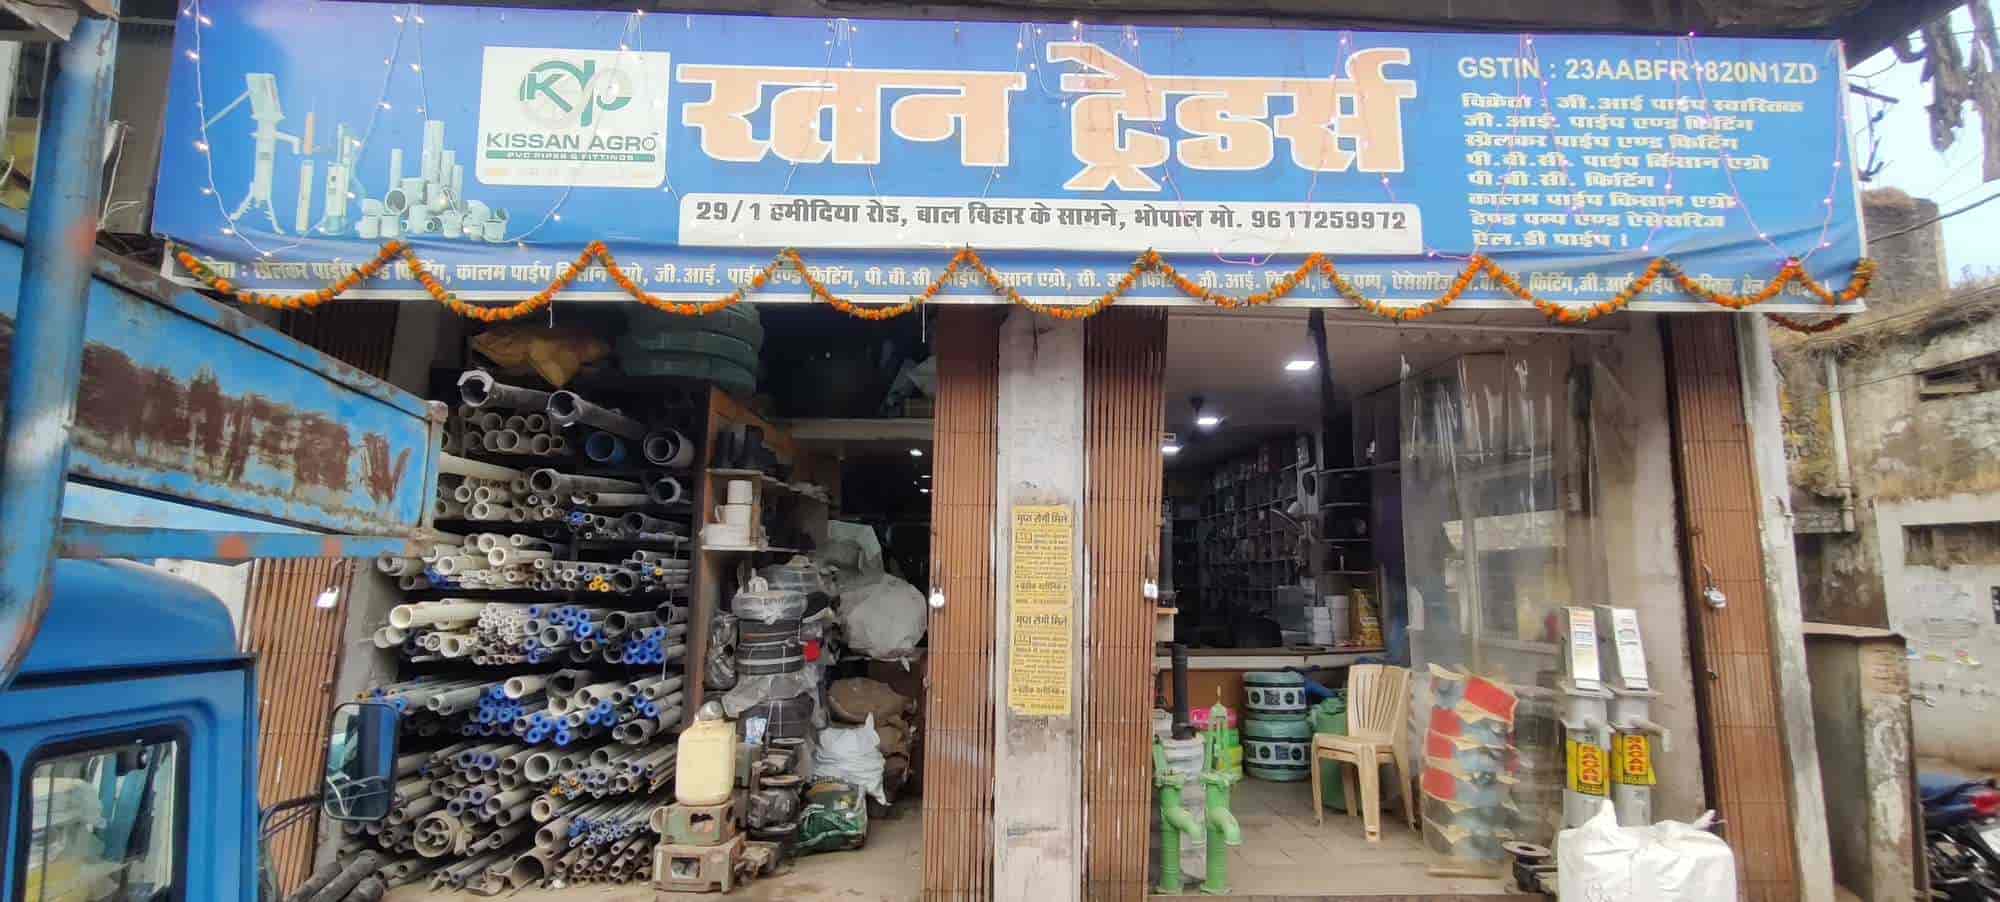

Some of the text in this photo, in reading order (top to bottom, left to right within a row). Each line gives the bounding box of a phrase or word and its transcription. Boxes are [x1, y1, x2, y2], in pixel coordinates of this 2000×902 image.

[1457, 57, 1541, 80] GSTIN
[1565, 58, 1818, 84] 23AABFR1820N1ZD
[676, 41, 1417, 191] रतन ट्रेडर्स
[1568, 114, 1626, 130] पाईप
[486, 132, 657, 151] KISSAN AGRO
[1553, 132, 1611, 149] पाईप
[1582, 153, 1640, 168] पाईप
[696, 198, 1406, 230] 29/1 हमीदिया रोड, बाल बिहार के सामने, भोपाल मो. 9617259972
[1553, 231, 1612, 247] पाईप
[456, 263, 505, 282] कालम
[511, 261, 553, 284] पाईप
